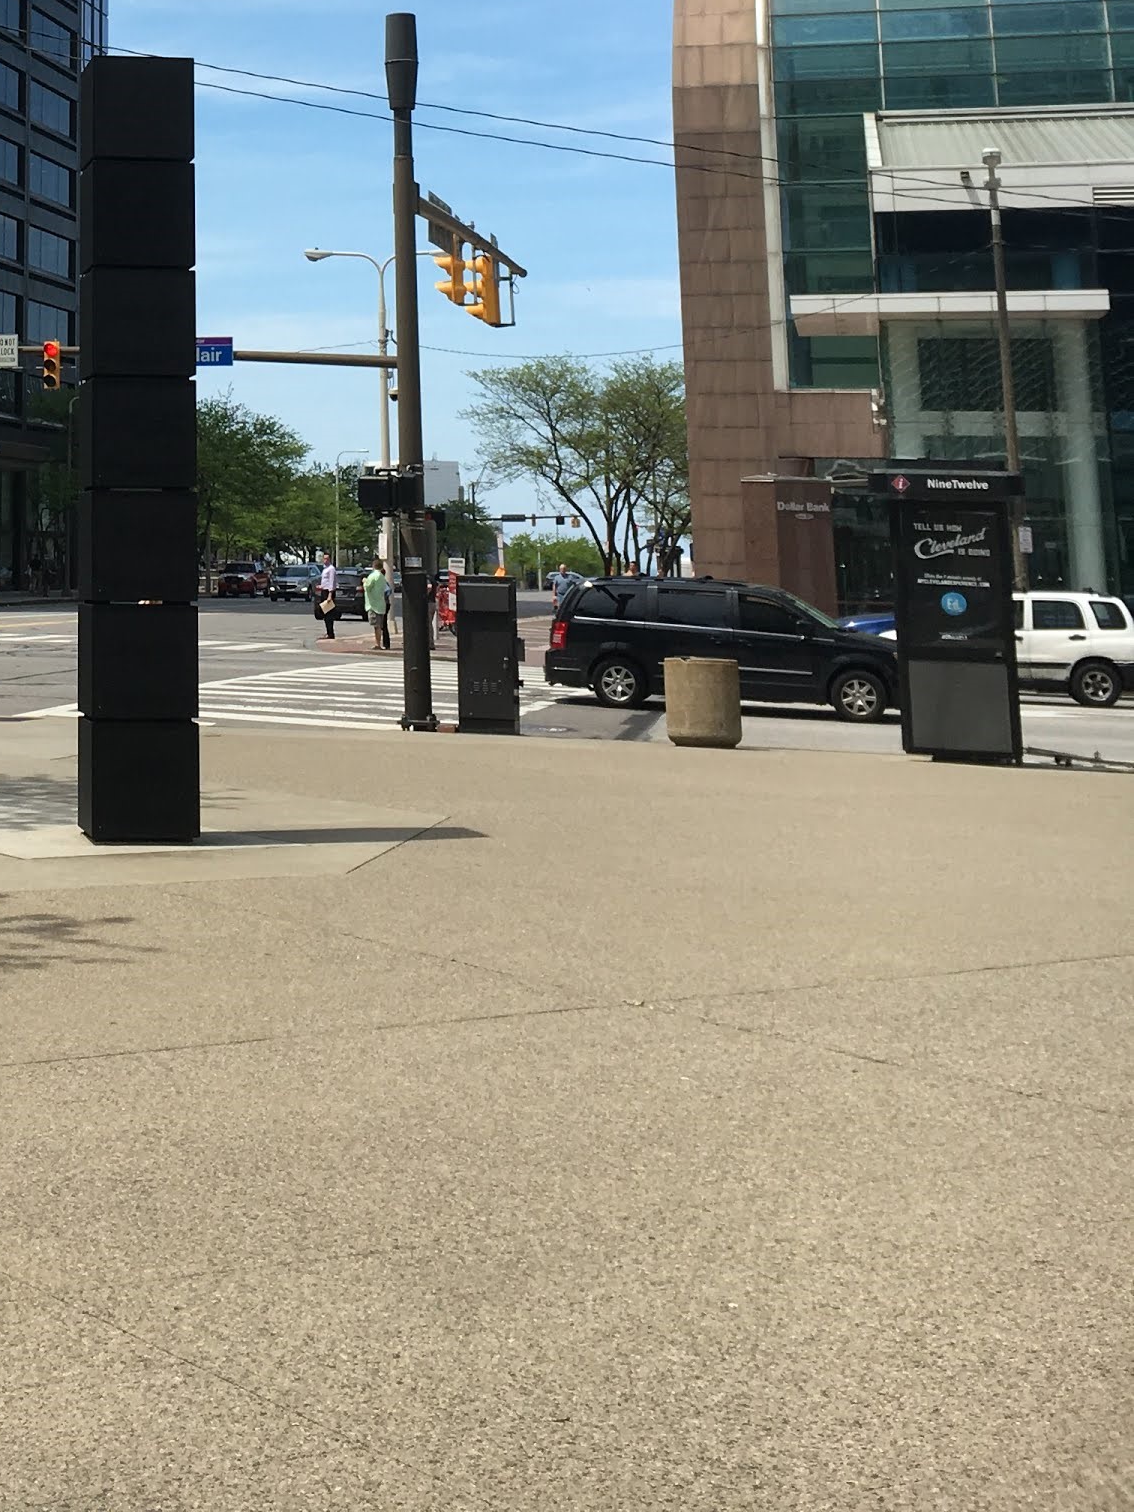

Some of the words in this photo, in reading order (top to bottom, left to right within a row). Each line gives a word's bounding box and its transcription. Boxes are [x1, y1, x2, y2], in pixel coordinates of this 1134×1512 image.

[5, 338, 15, 346] NOT
[927, 478, 989, 490] NineTwelve
[777, 501, 804, 511] Dollar
[806, 502, 831, 512] Bank
[913, 522, 932, 531] TELL
[913, 527, 987, 559] Cleveland
